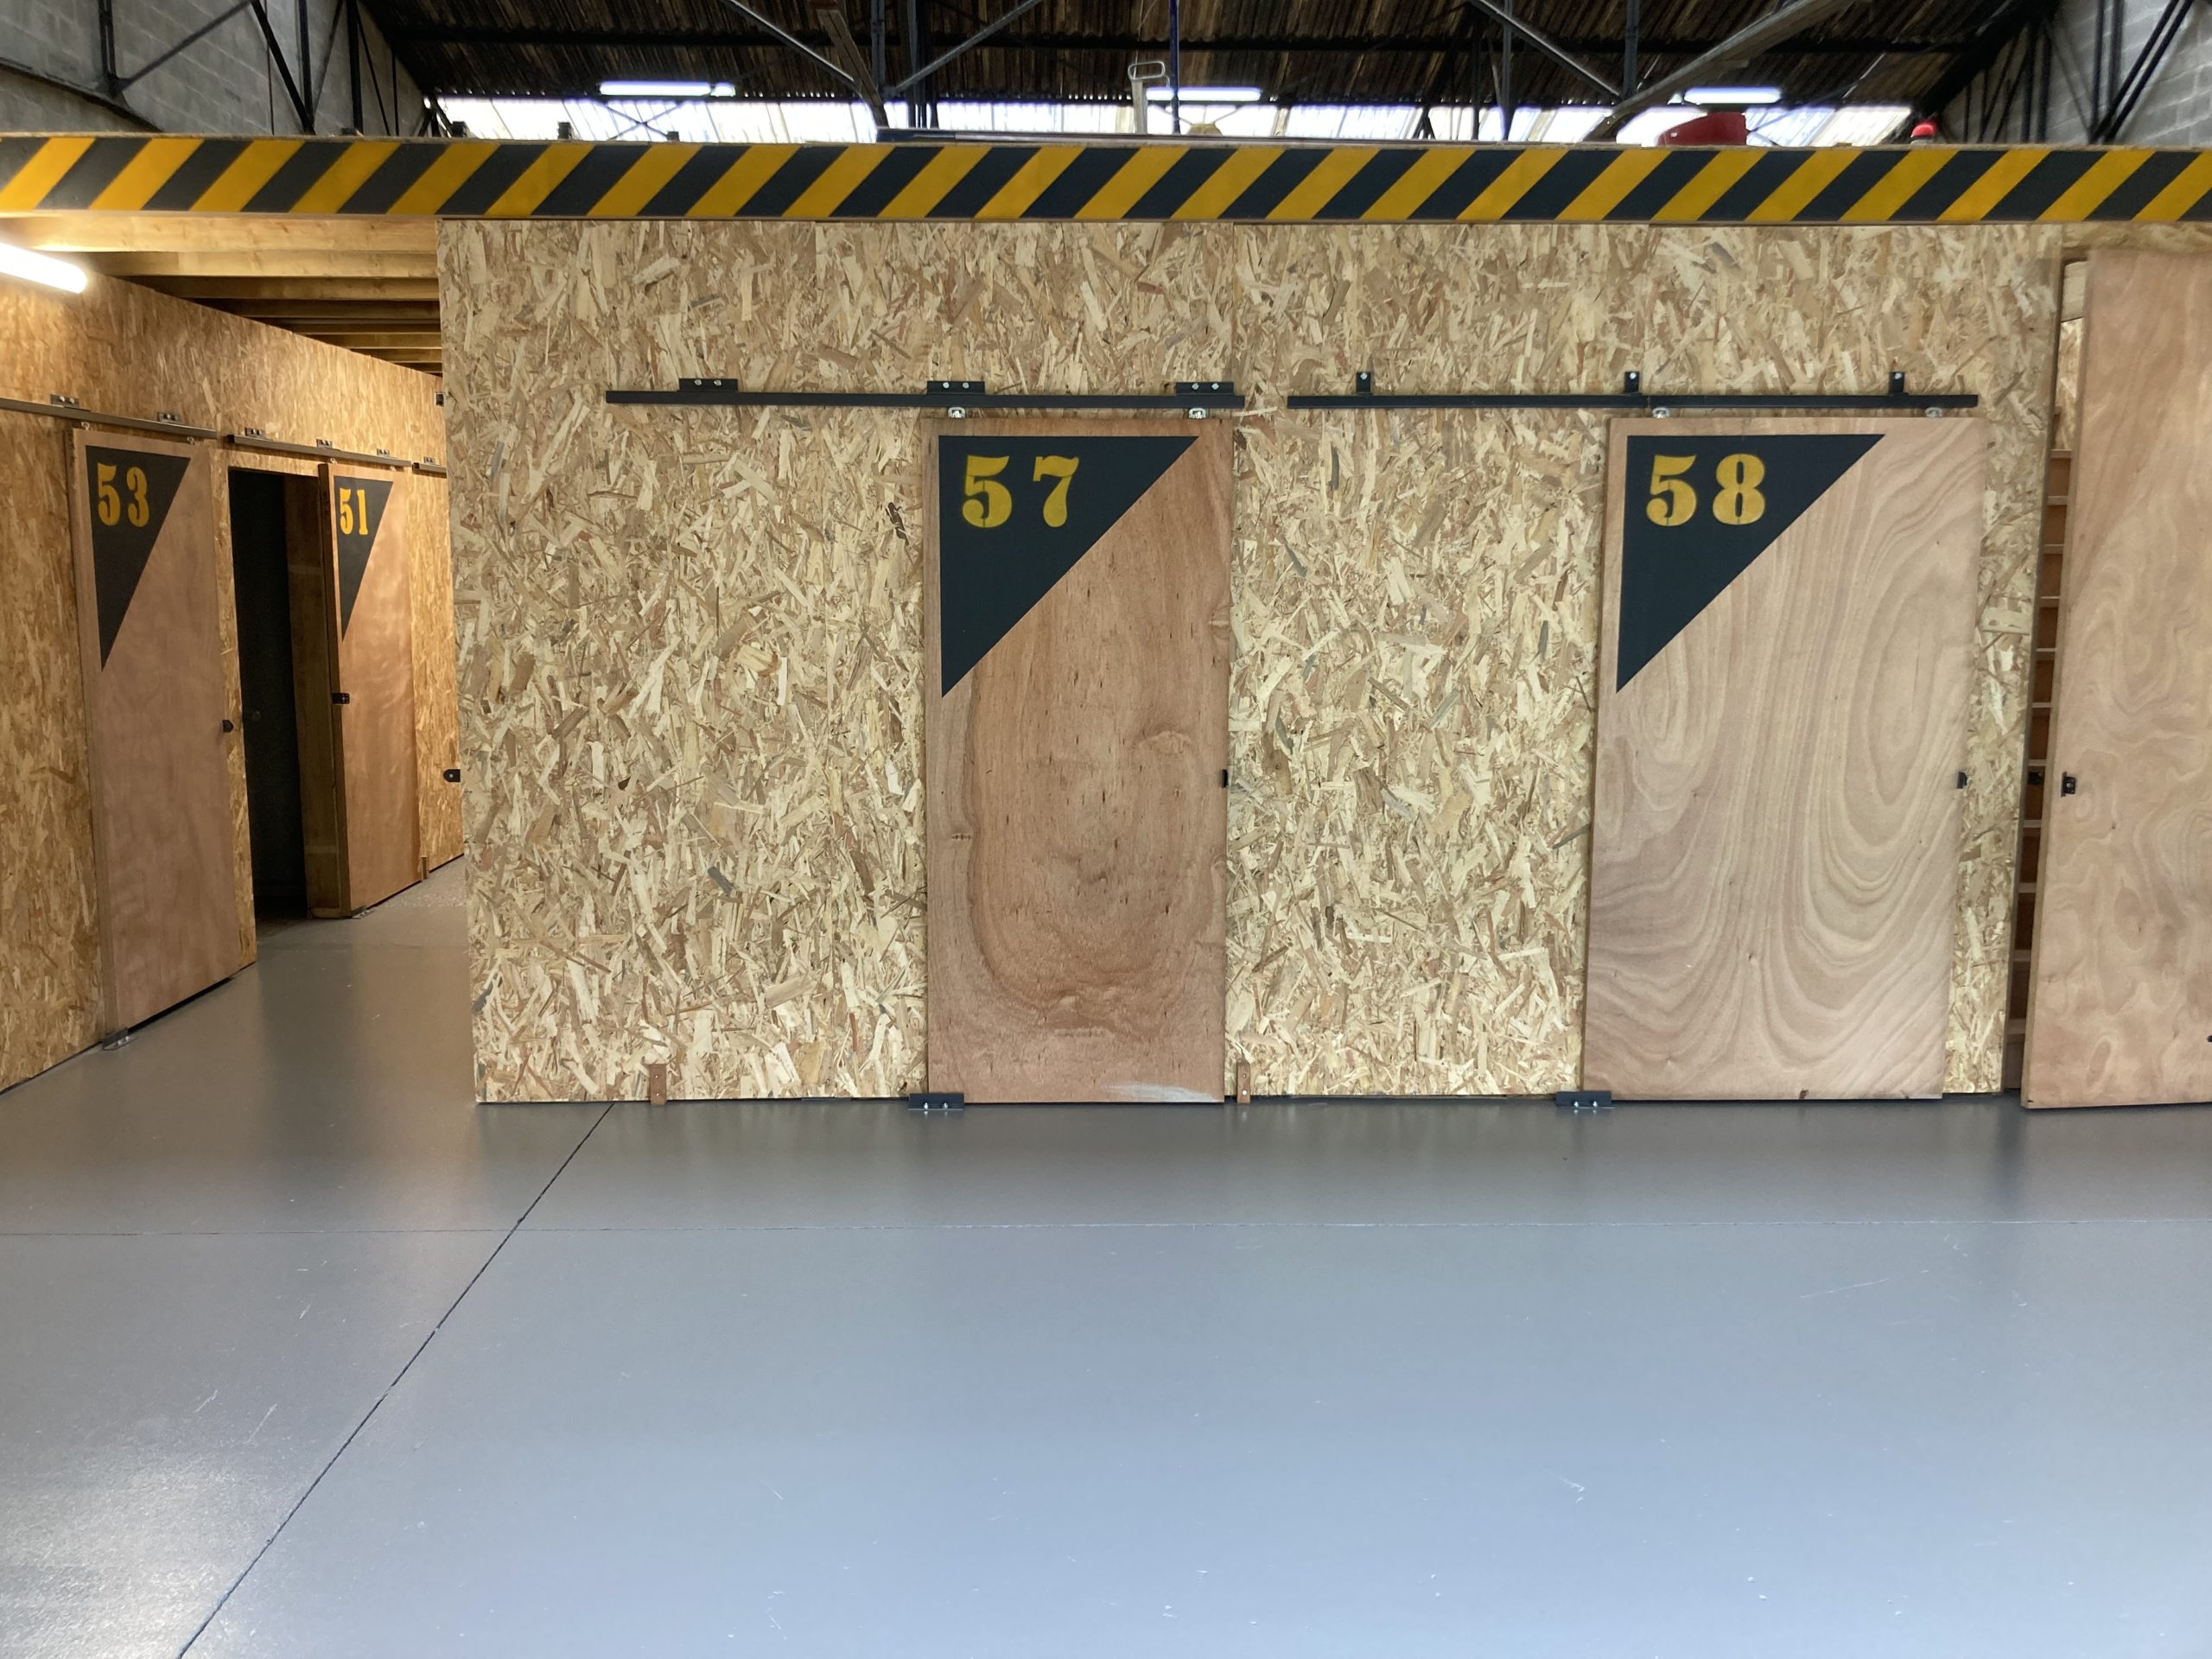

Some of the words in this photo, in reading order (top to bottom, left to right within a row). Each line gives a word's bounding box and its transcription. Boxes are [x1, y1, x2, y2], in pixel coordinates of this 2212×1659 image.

[97, 462, 150, 526] 53
[339, 487, 369, 536] 51
[961, 455, 1079, 528] 57
[1646, 454, 1765, 526] 58
